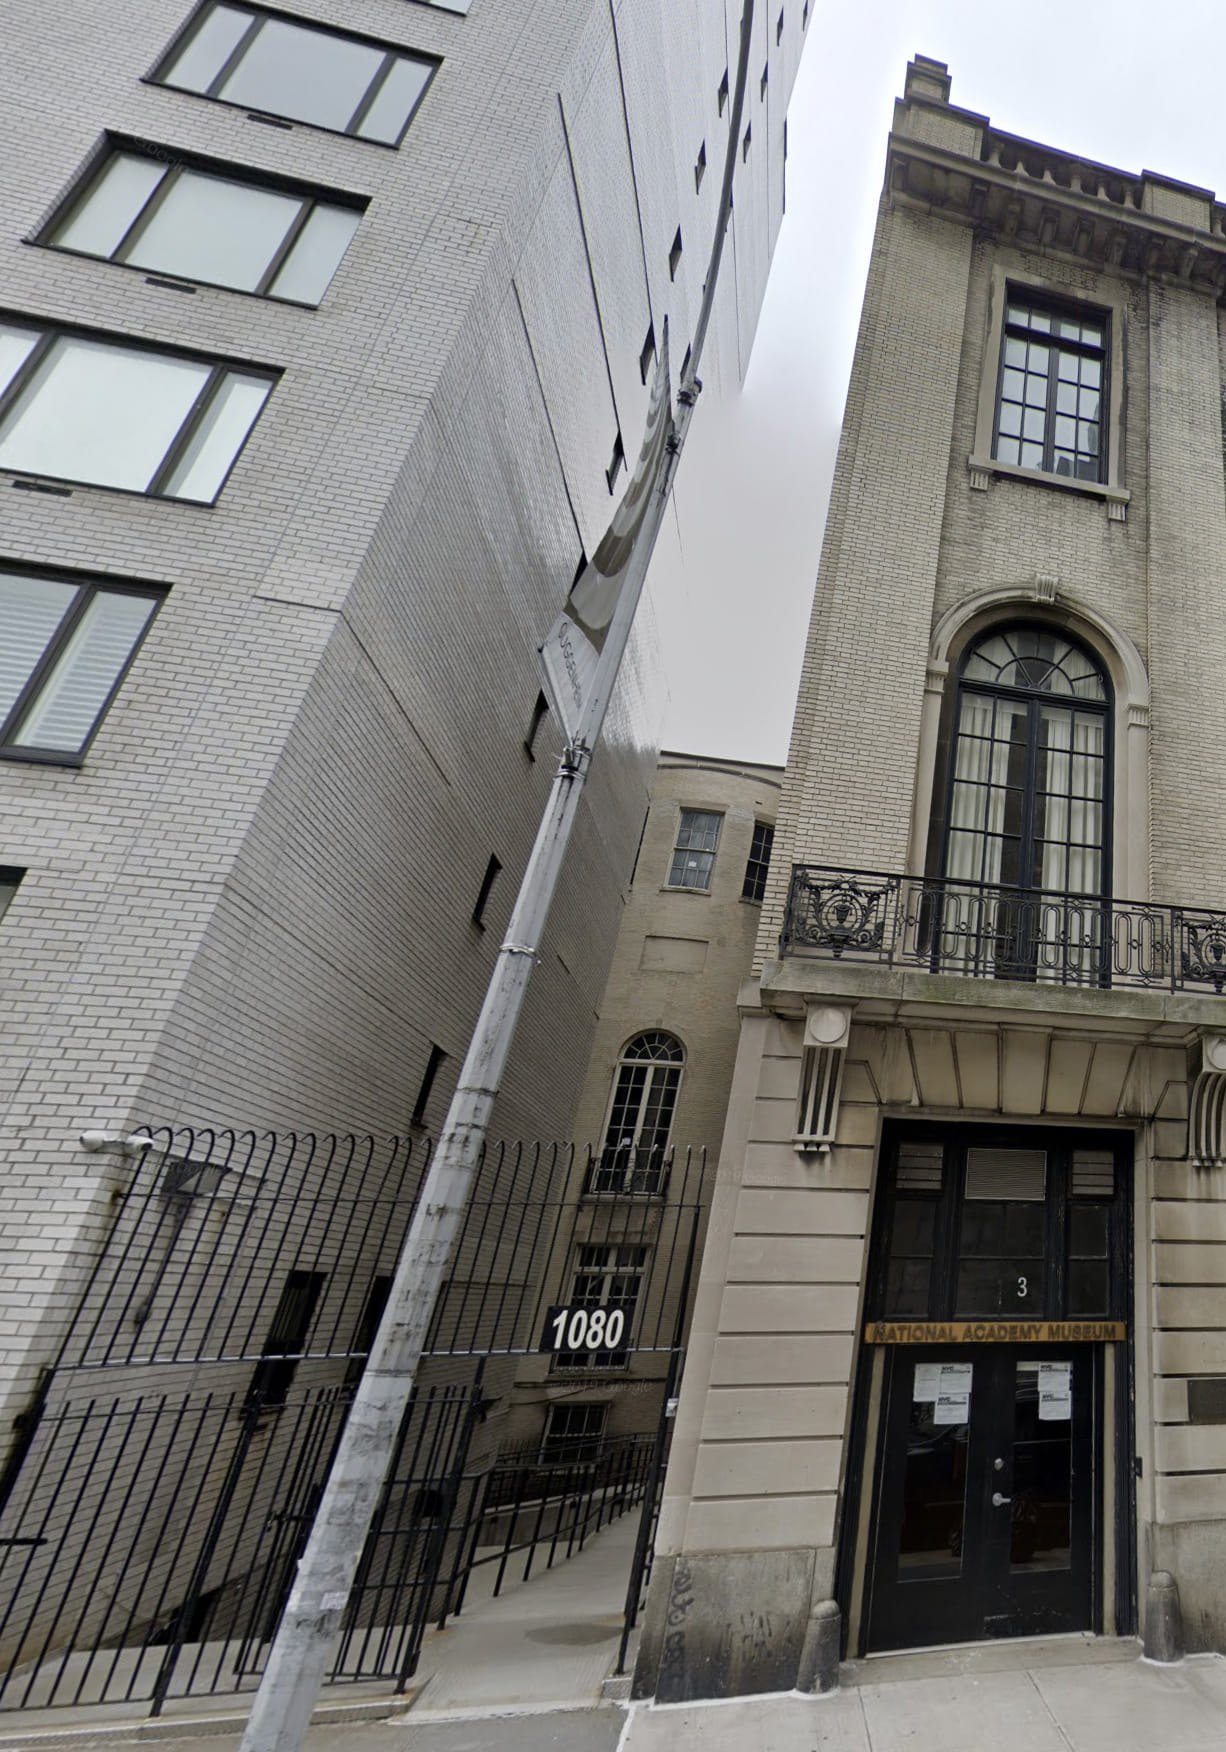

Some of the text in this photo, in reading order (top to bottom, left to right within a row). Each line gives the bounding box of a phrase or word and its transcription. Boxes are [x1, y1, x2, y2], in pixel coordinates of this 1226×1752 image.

[1017, 1276, 1028, 1297] 3
[552, 1309, 625, 1350] 1080
[873, 1324, 1117, 1341] NATIONAL ACADEMY MUSEUM
